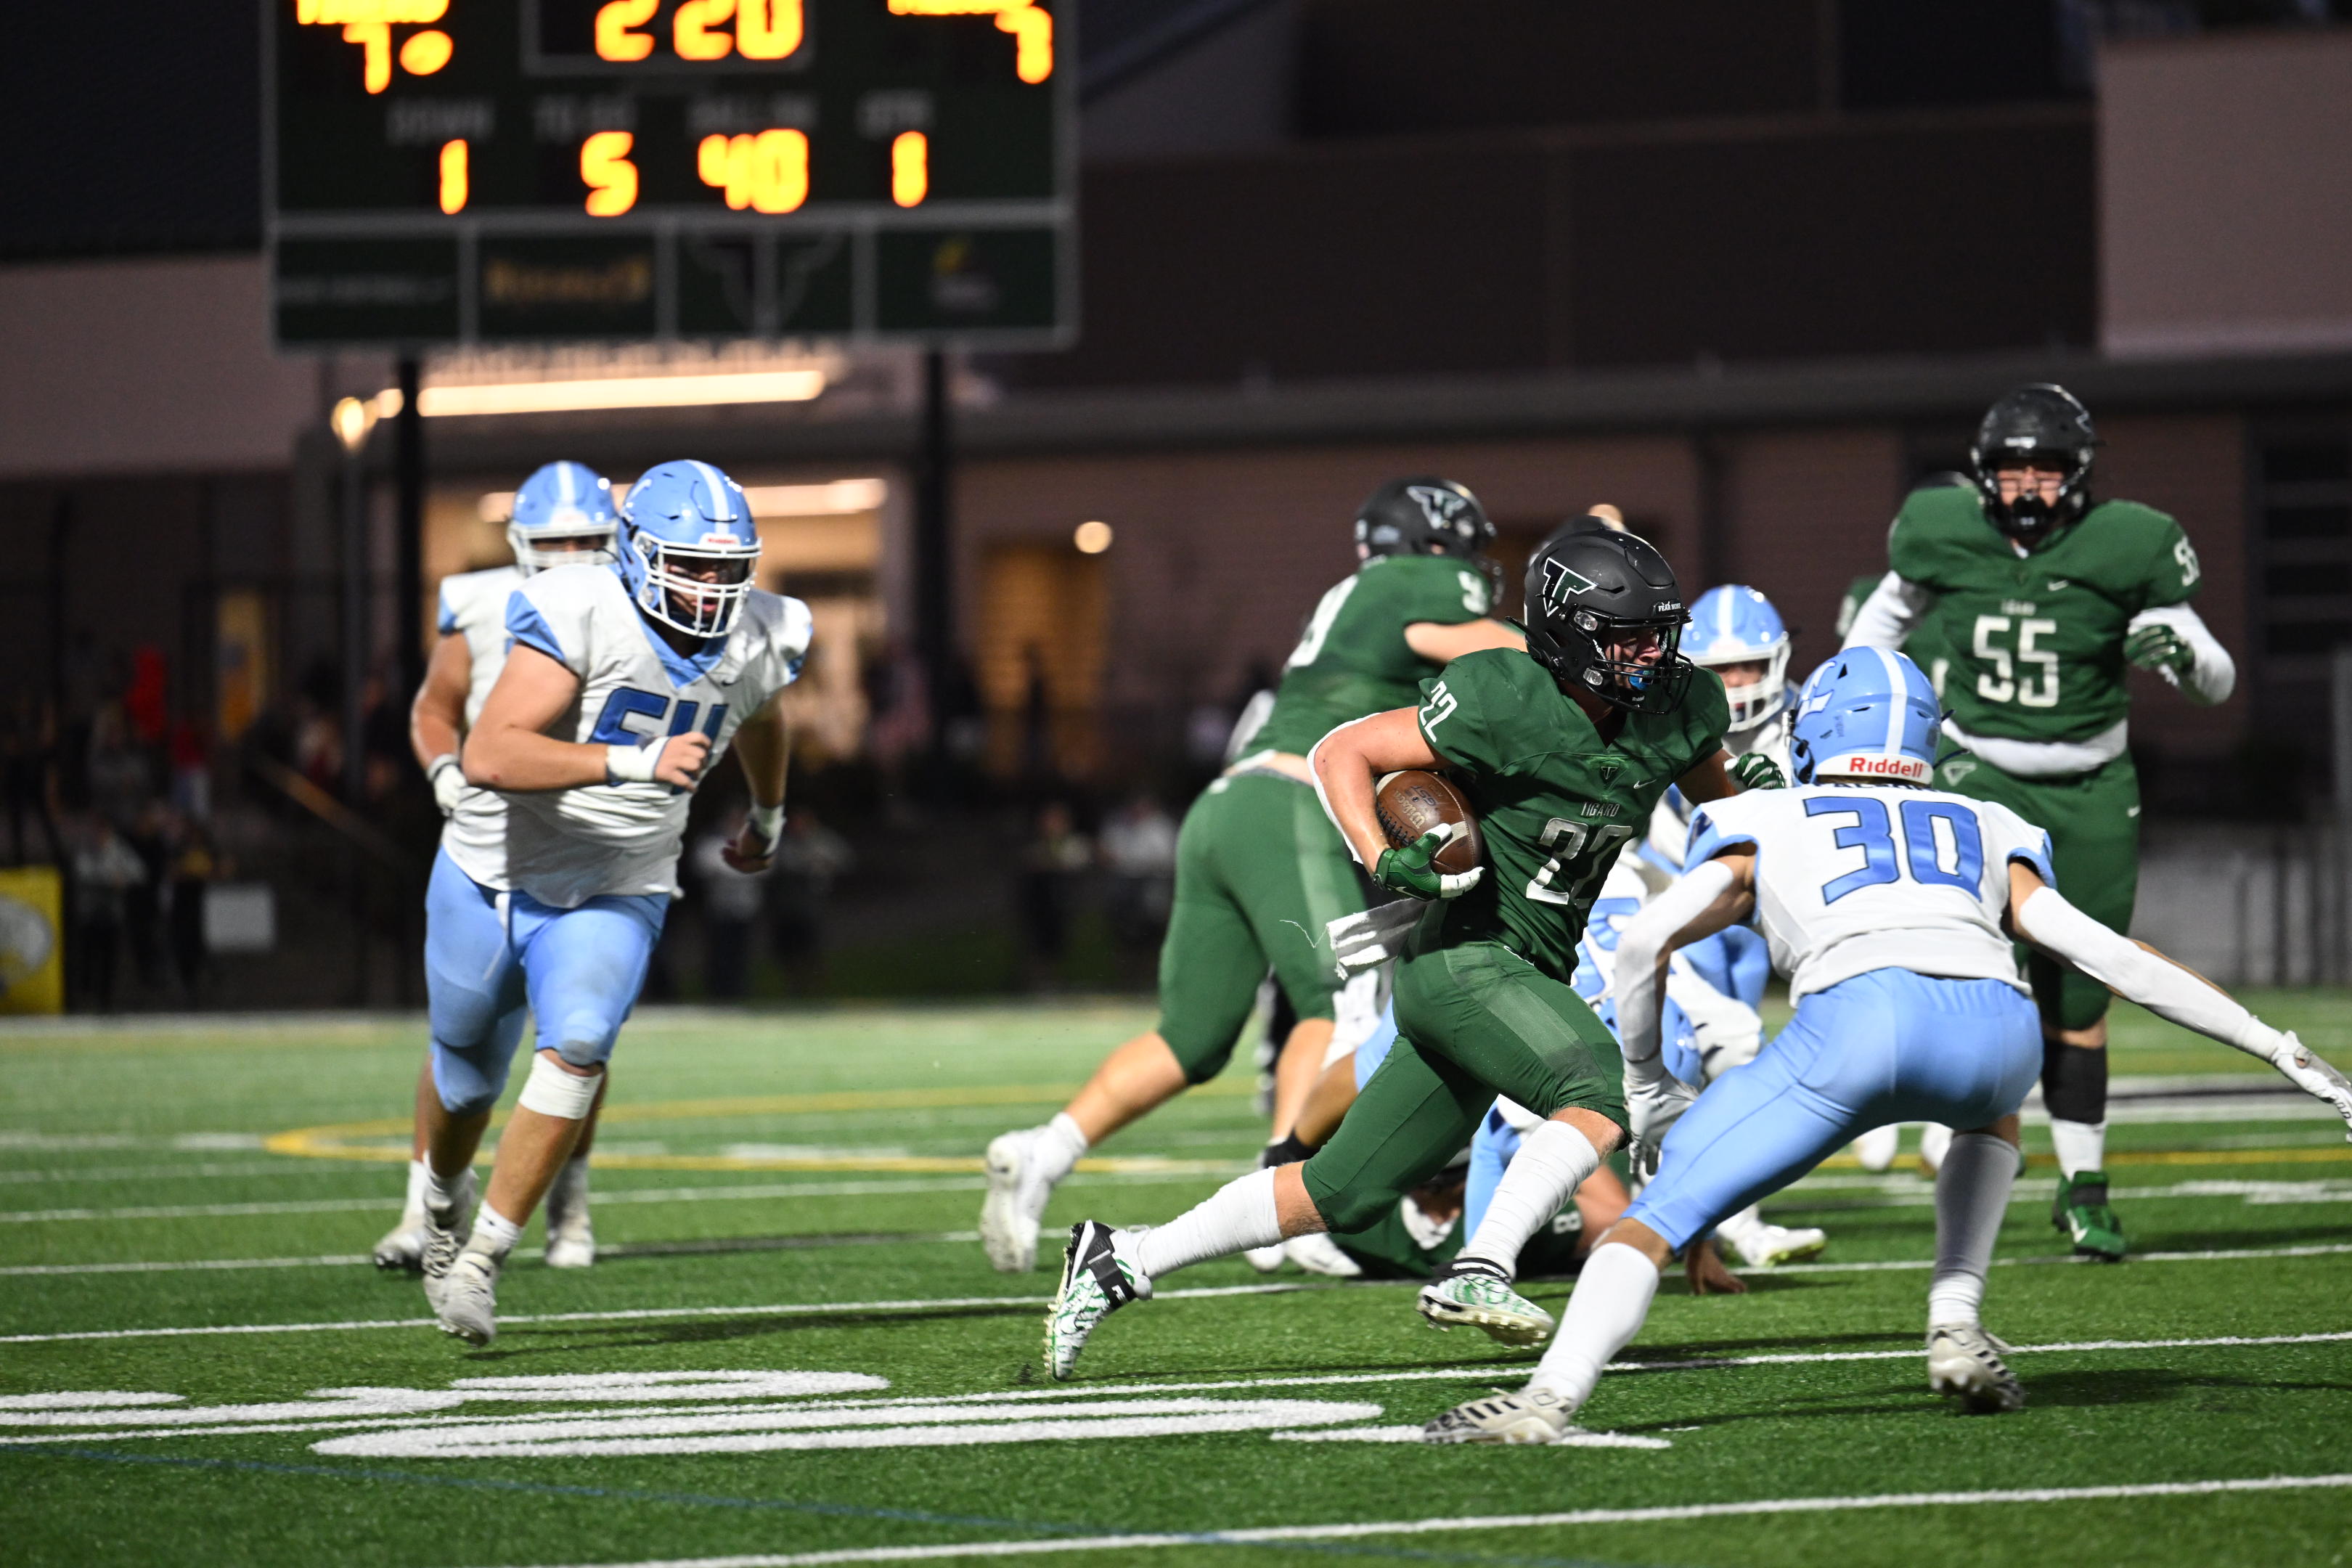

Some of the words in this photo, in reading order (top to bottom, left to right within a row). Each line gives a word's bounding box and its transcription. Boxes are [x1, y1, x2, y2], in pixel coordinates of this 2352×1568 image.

[440, 139, 469, 215] 1
[580, 131, 639, 216] 5
[698, 128, 809, 213] 40
[892, 131, 928, 208] 1
[1972, 615, 2059, 708] 55
[1419, 680, 1458, 743] 22
[1410, 785, 1437, 807] GST
[1849, 756, 1924, 779] Riddell
[1393, 790, 1426, 830] Wilson
[1580, 801, 1620, 818] TIGARD
[1525, 817, 1634, 911] 22
[1803, 796, 1985, 906] 30
